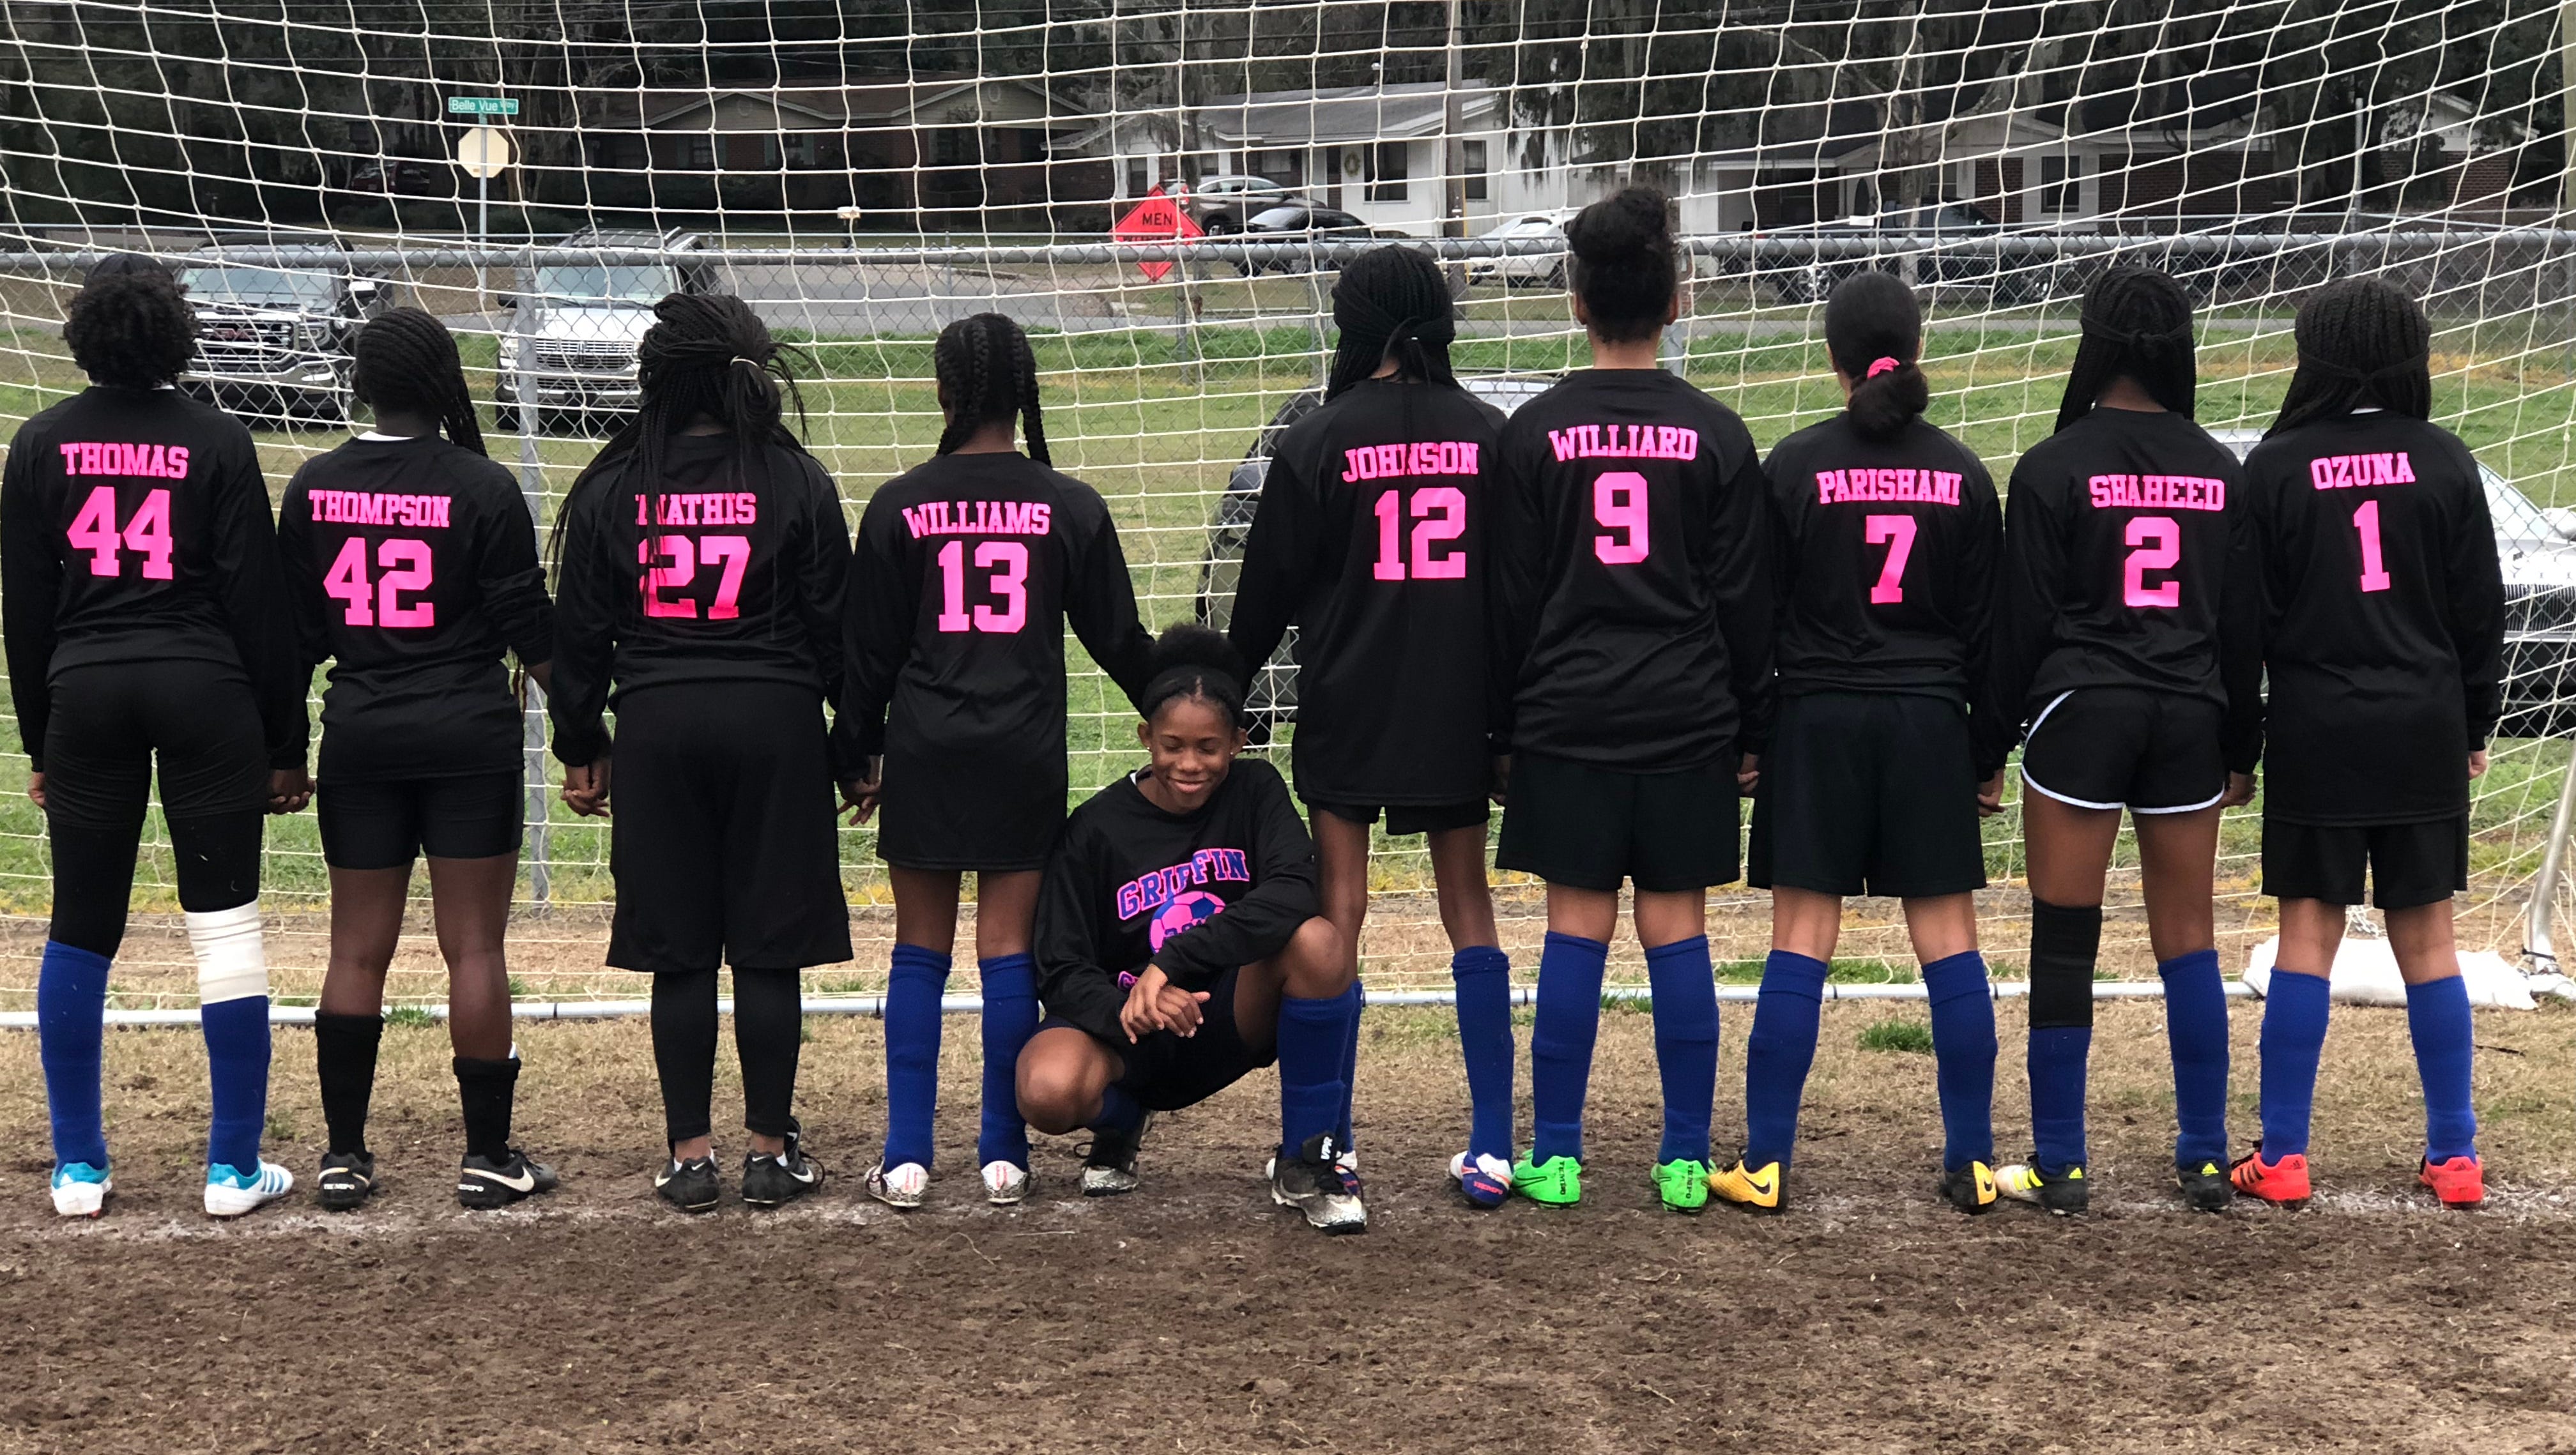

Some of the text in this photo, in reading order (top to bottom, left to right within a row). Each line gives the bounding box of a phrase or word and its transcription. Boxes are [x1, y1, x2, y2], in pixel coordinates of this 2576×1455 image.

[452, 100, 475, 110] Belle
[479, 100, 498, 111] Vue
[1142, 213, 1172, 225] MEN
[59, 442, 190, 479] THOMAS
[1342, 441, 1479, 483] JOHNSON
[1548, 424, 1698, 462] WILLIARD
[2310, 452, 2416, 490] OZUNA
[308, 489, 452, 528] THOMPSON
[1816, 468, 1963, 506] PARISHANI
[2089, 474, 2225, 512] SHAHEED
[66, 485, 173, 580] 44
[901, 501, 1051, 539] WILLIAMS
[1374, 487, 1466, 581] 12
[1593, 471, 1649, 565] 9
[2353, 500, 2391, 593] 1
[323, 537, 434, 628] 42
[638, 535, 751, 620] 27
[938, 540, 1029, 634] 13
[1866, 515, 1917, 604] 7
[2124, 517, 2180, 607] 2
[1117, 848, 1250, 920] GRIFFIN
